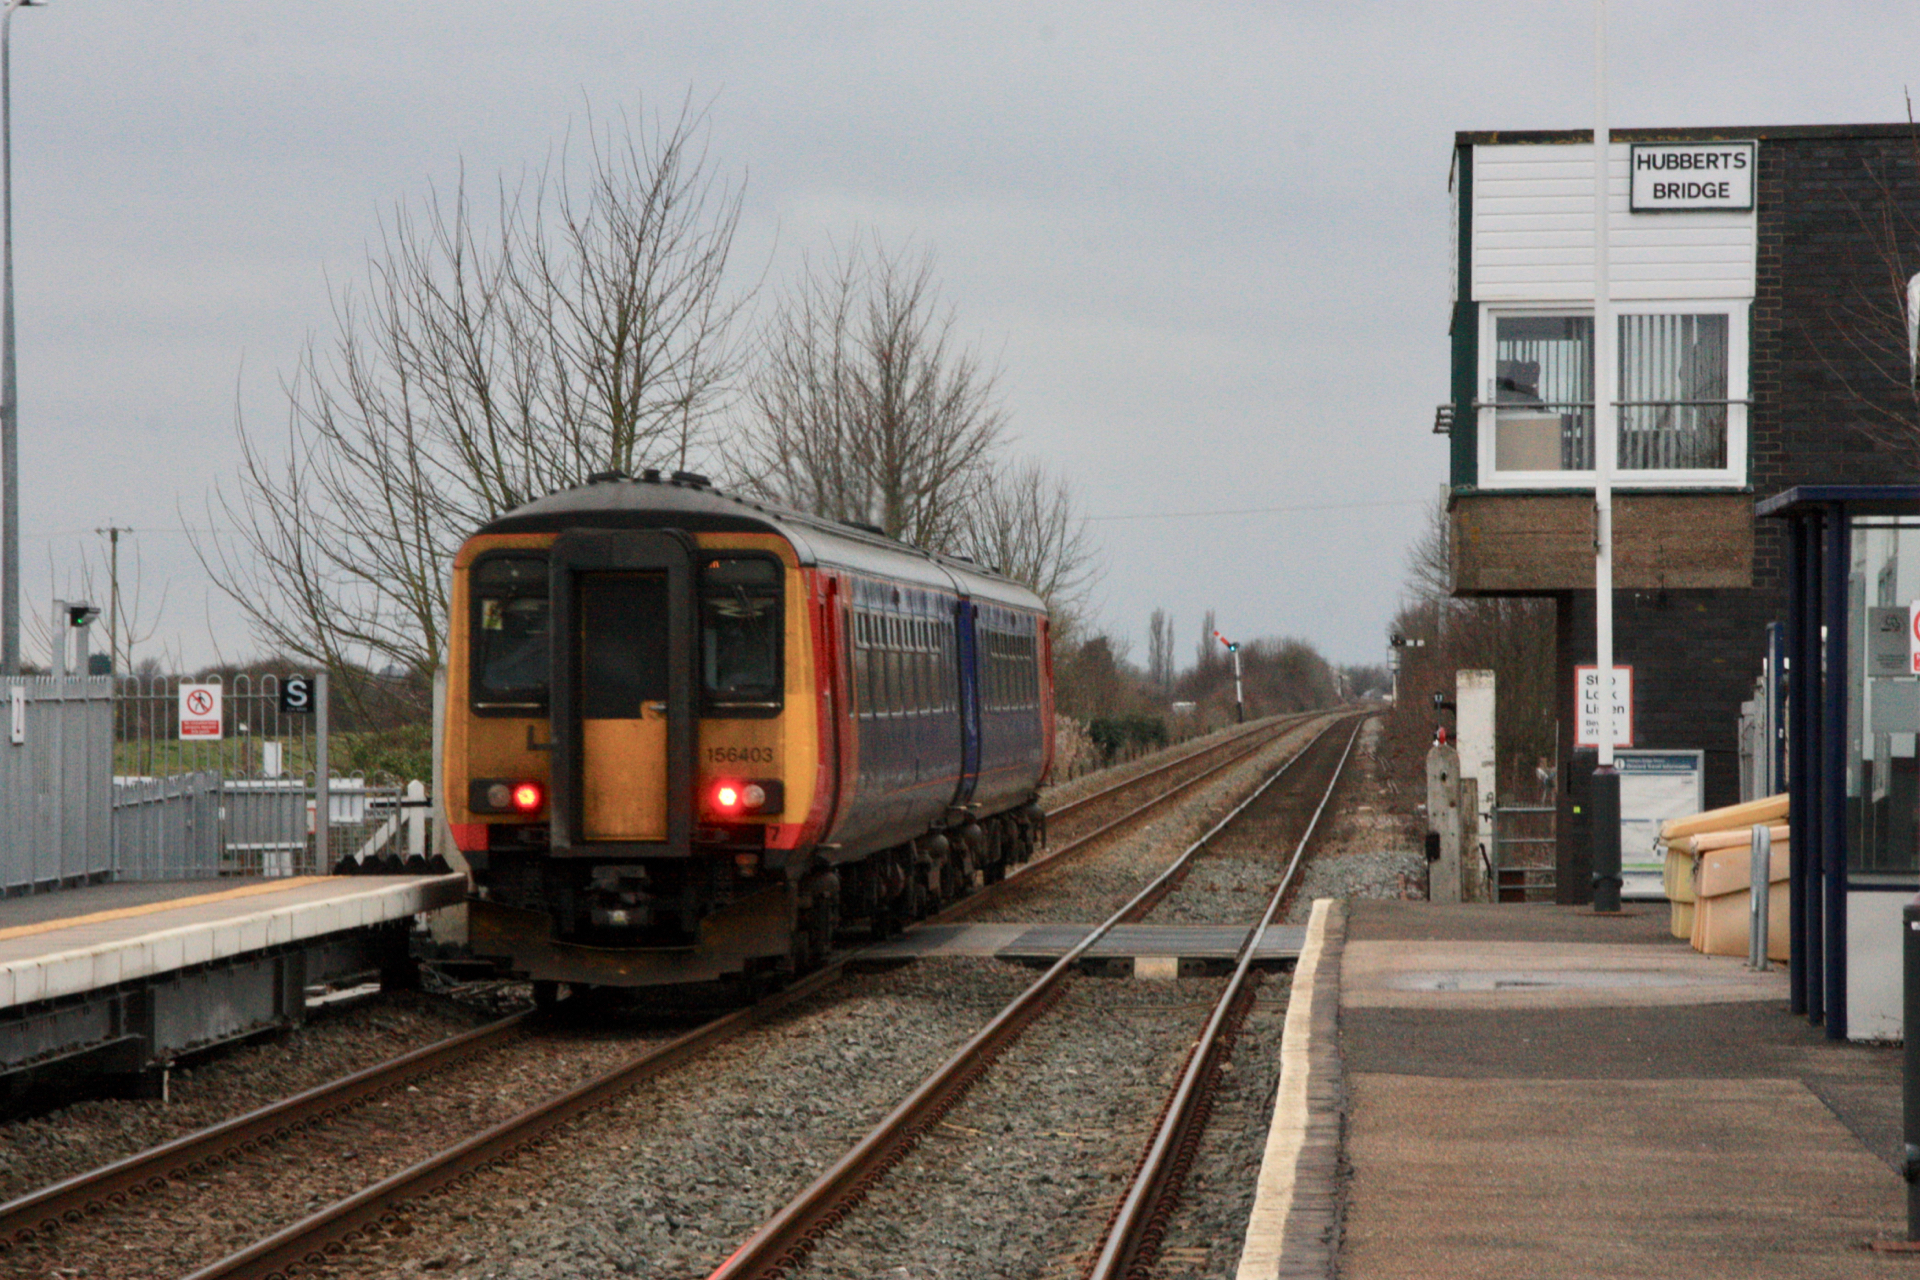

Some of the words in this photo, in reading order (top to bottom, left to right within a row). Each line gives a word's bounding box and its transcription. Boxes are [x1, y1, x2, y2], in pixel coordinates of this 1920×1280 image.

[1637, 152, 1747, 170] HUBBERTS
[1653, 182, 1730, 199] BRIDGE
[1586, 674, 1616, 686] St
[286, 680, 308, 706] S
[1586, 689, 1617, 700] Lok
[707, 747, 774, 763] 156403
